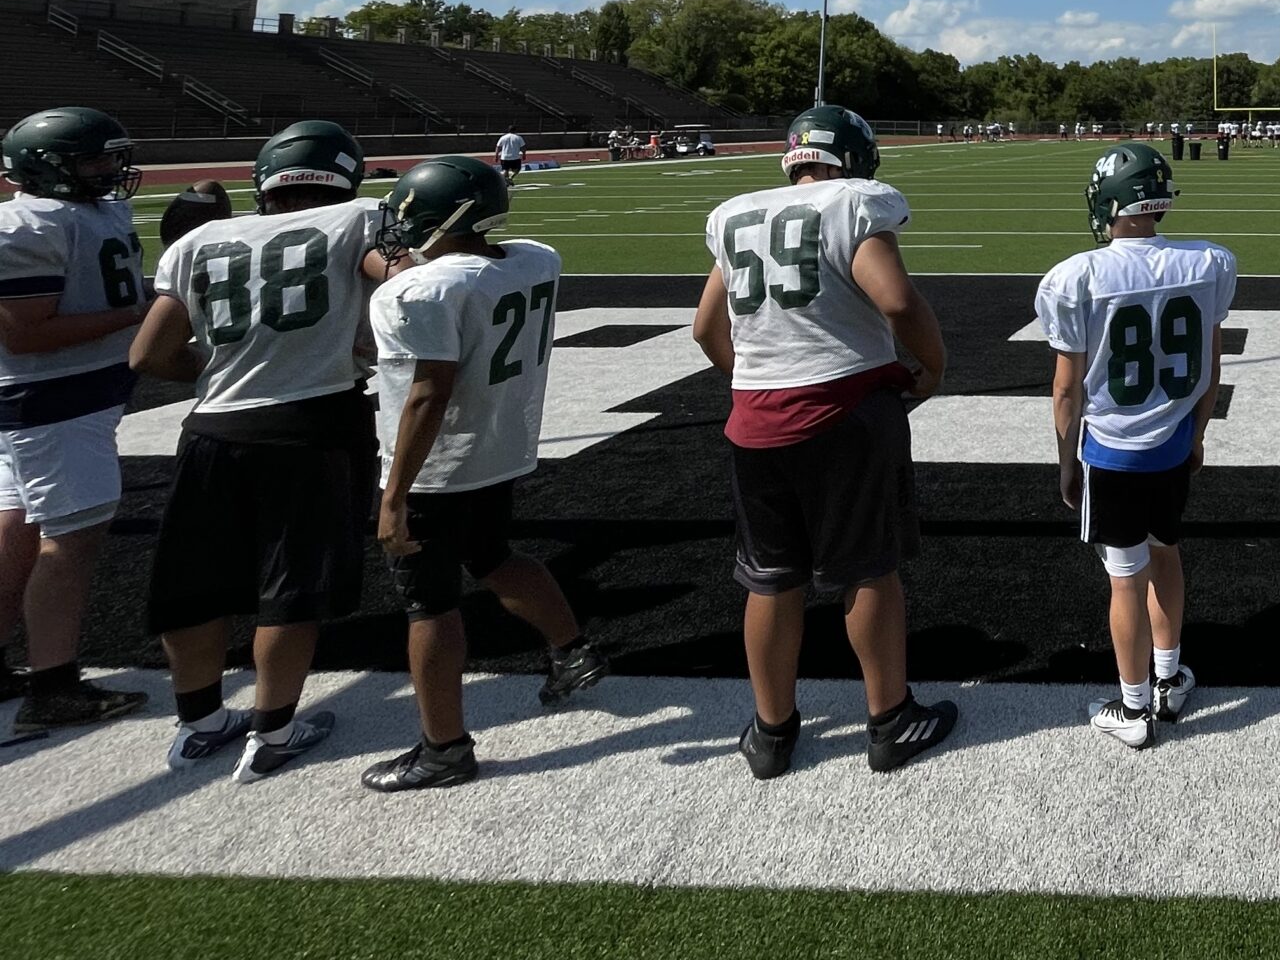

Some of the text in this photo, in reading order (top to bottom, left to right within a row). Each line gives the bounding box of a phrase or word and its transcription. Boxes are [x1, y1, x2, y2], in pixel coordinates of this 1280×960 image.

[280, 173, 335, 182] Riddell
[784, 151, 820, 166] Riddell
[193, 227, 329, 346] 88
[724, 203, 821, 315] 59
[489, 280, 556, 386] 27
[1108, 296, 1202, 406] 89
